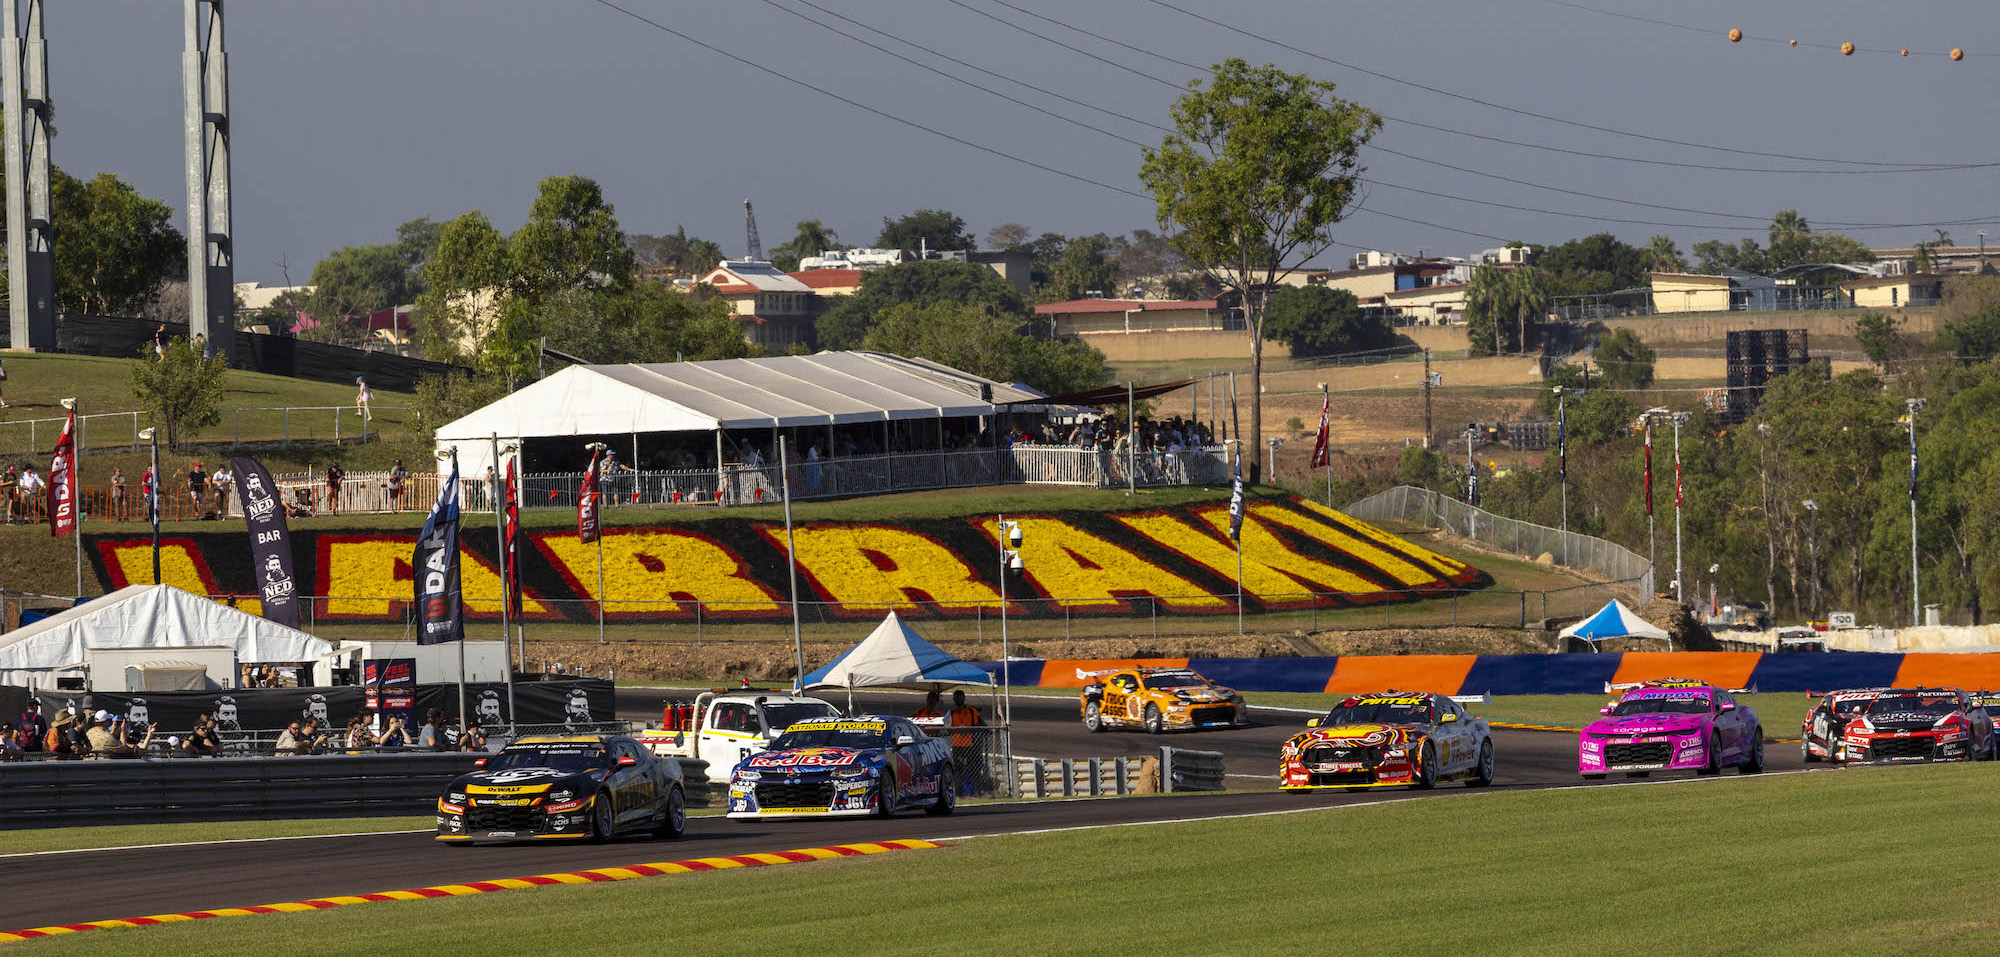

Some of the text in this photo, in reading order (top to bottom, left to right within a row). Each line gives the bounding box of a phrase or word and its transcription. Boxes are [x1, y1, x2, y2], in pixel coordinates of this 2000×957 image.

[250, 498, 275, 517] NED
[257, 529, 281, 545] BAR
[264, 580, 293, 599] NED
[385, 663, 410, 676] FEEL
[1642, 692, 1710, 700] MIDDY'S
[749, 755, 857, 768] Red Bull
